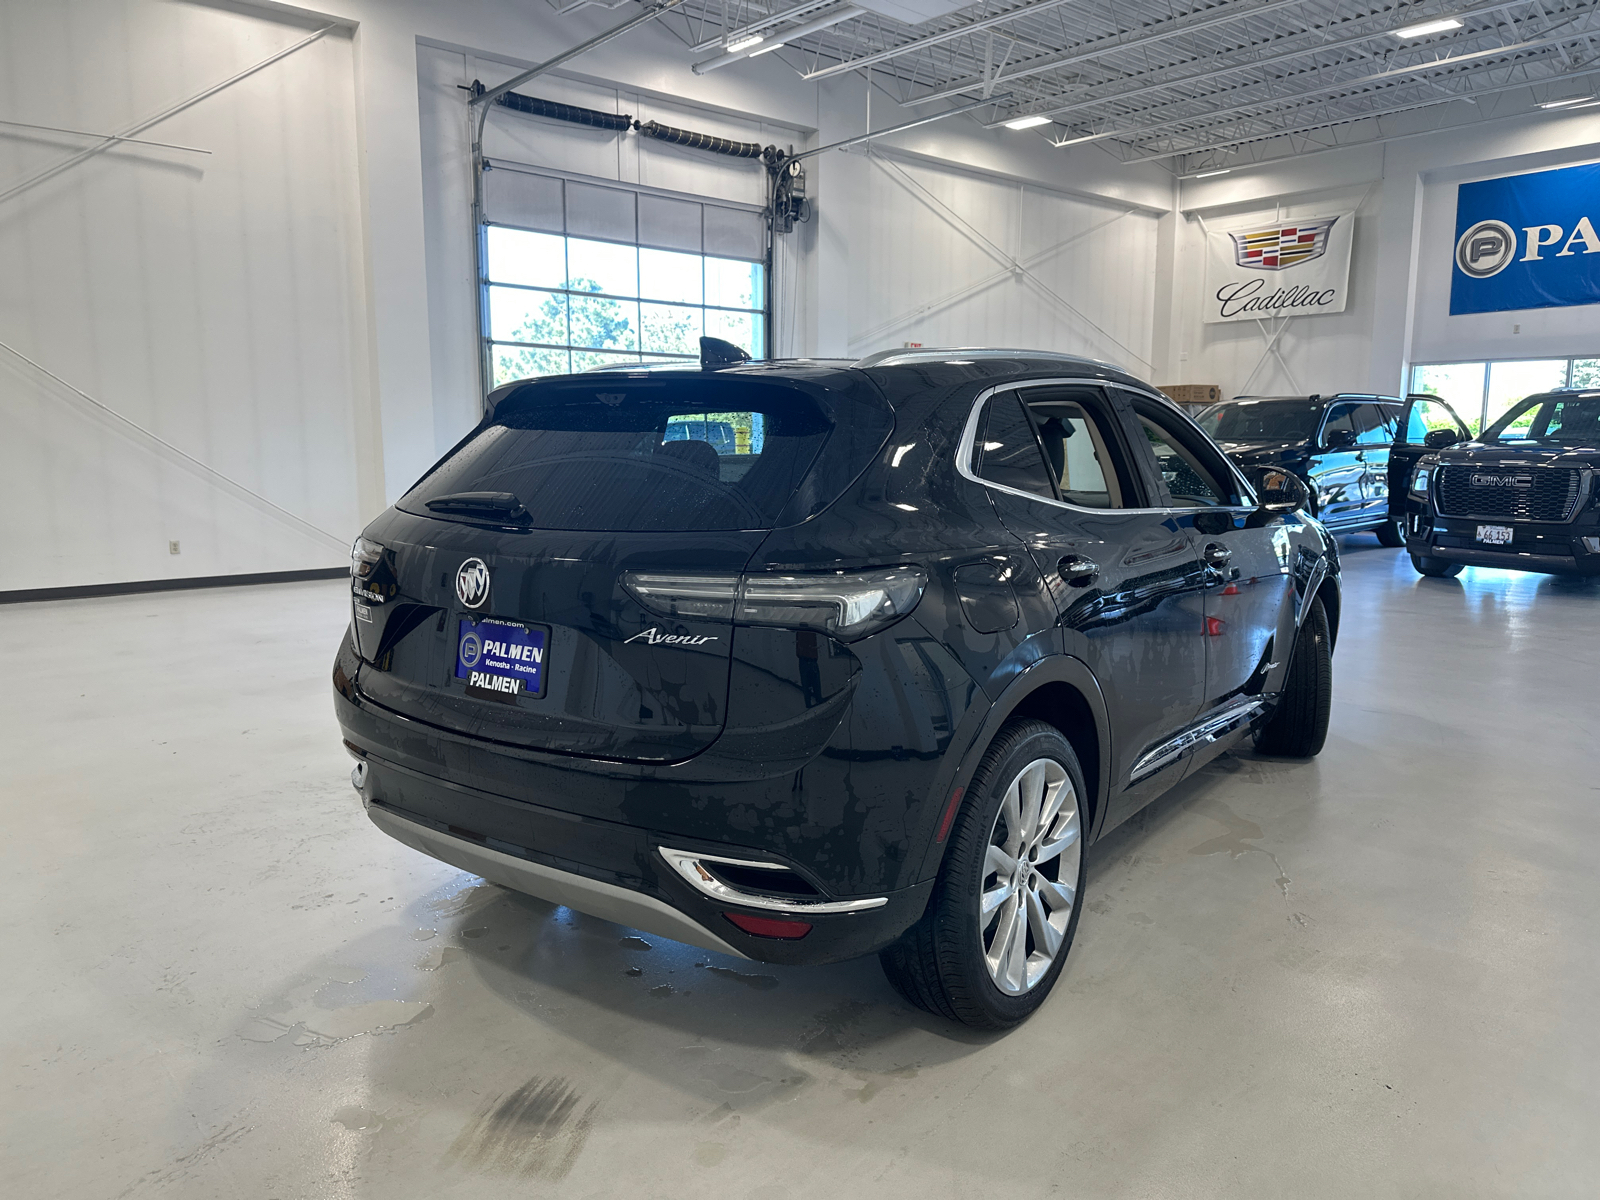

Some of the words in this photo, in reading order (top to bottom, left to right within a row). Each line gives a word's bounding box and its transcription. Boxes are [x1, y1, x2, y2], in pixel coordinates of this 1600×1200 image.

[1216, 278, 1335, 318] Cadillac
[1472, 474, 1532, 488] GMC
[1496, 530, 1511, 541] 153
[481, 617, 525, 629] almen.com
[623, 627, 719, 645] Avenir
[482, 639, 544, 664] PALMEN
[485, 658, 511, 670] Kenosha
[514, 663, 537, 675] Racine
[469, 671, 520, 695] PALMEN
